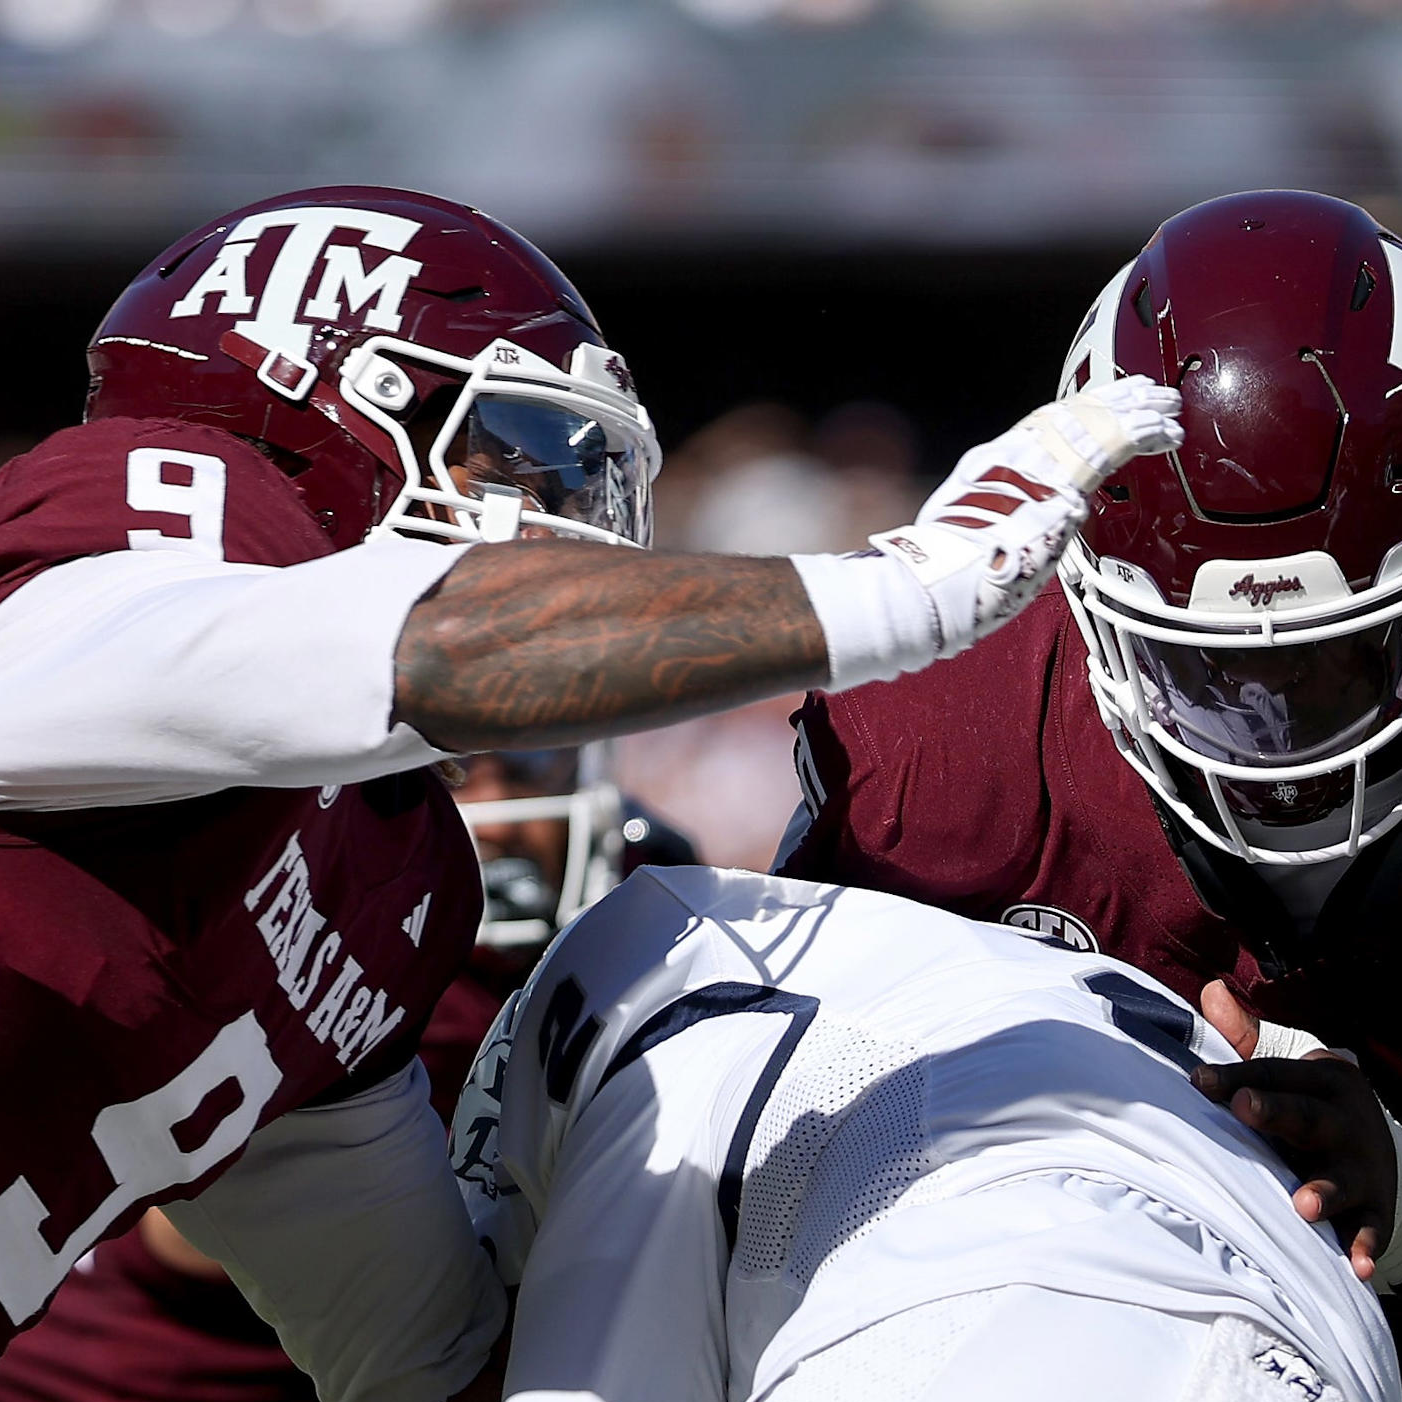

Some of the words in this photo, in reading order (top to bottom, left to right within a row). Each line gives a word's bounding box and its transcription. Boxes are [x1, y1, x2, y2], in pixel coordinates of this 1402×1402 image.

[126, 446, 226, 562] 9
[1229, 573, 1304, 606] Aggies
[244, 829, 342, 1011] TEXAS
[305, 954, 406, 1074] A&M
